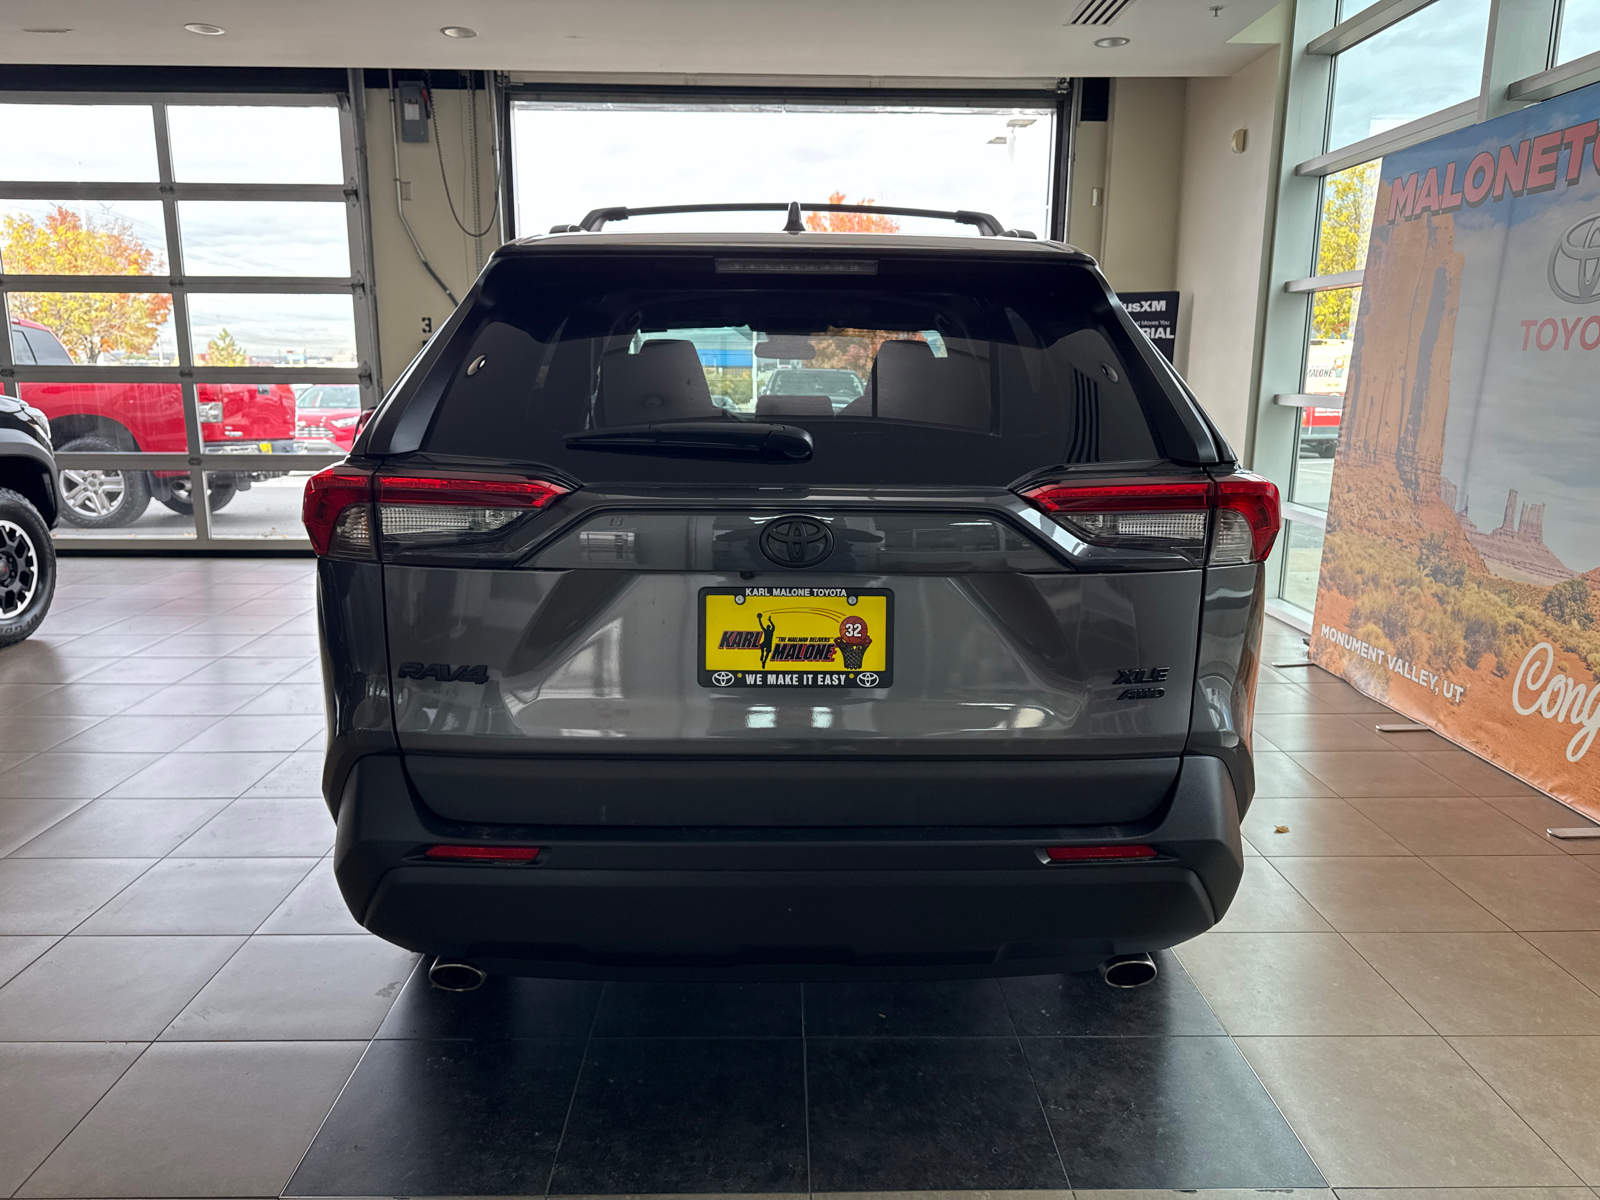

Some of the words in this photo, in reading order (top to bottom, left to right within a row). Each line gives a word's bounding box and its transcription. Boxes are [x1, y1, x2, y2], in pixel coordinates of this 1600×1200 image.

[1387, 118, 1600, 226] MALONET
[422, 317, 432, 333] 3
[745, 588, 770, 597] KARL
[772, 588, 810, 597] MALONE
[812, 588, 847, 597] TOYOTA
[845, 623, 862, 637] 32
[718, 630, 763, 650] KARL
[770, 643, 837, 662] MALONE
[1321, 623, 1385, 665] MONUMENT
[1387, 653, 1439, 696] VALLEY,
[1442, 681, 1465, 703] UT
[398, 662, 490, 685] RAV4
[745, 674, 763, 685] WE
[767, 674, 799, 685] MAKE
[803, 674, 814, 685] IT
[817, 674, 846, 685] EASY
[1112, 667, 1170, 685] XLE
[1117, 687, 1166, 700] AWD
